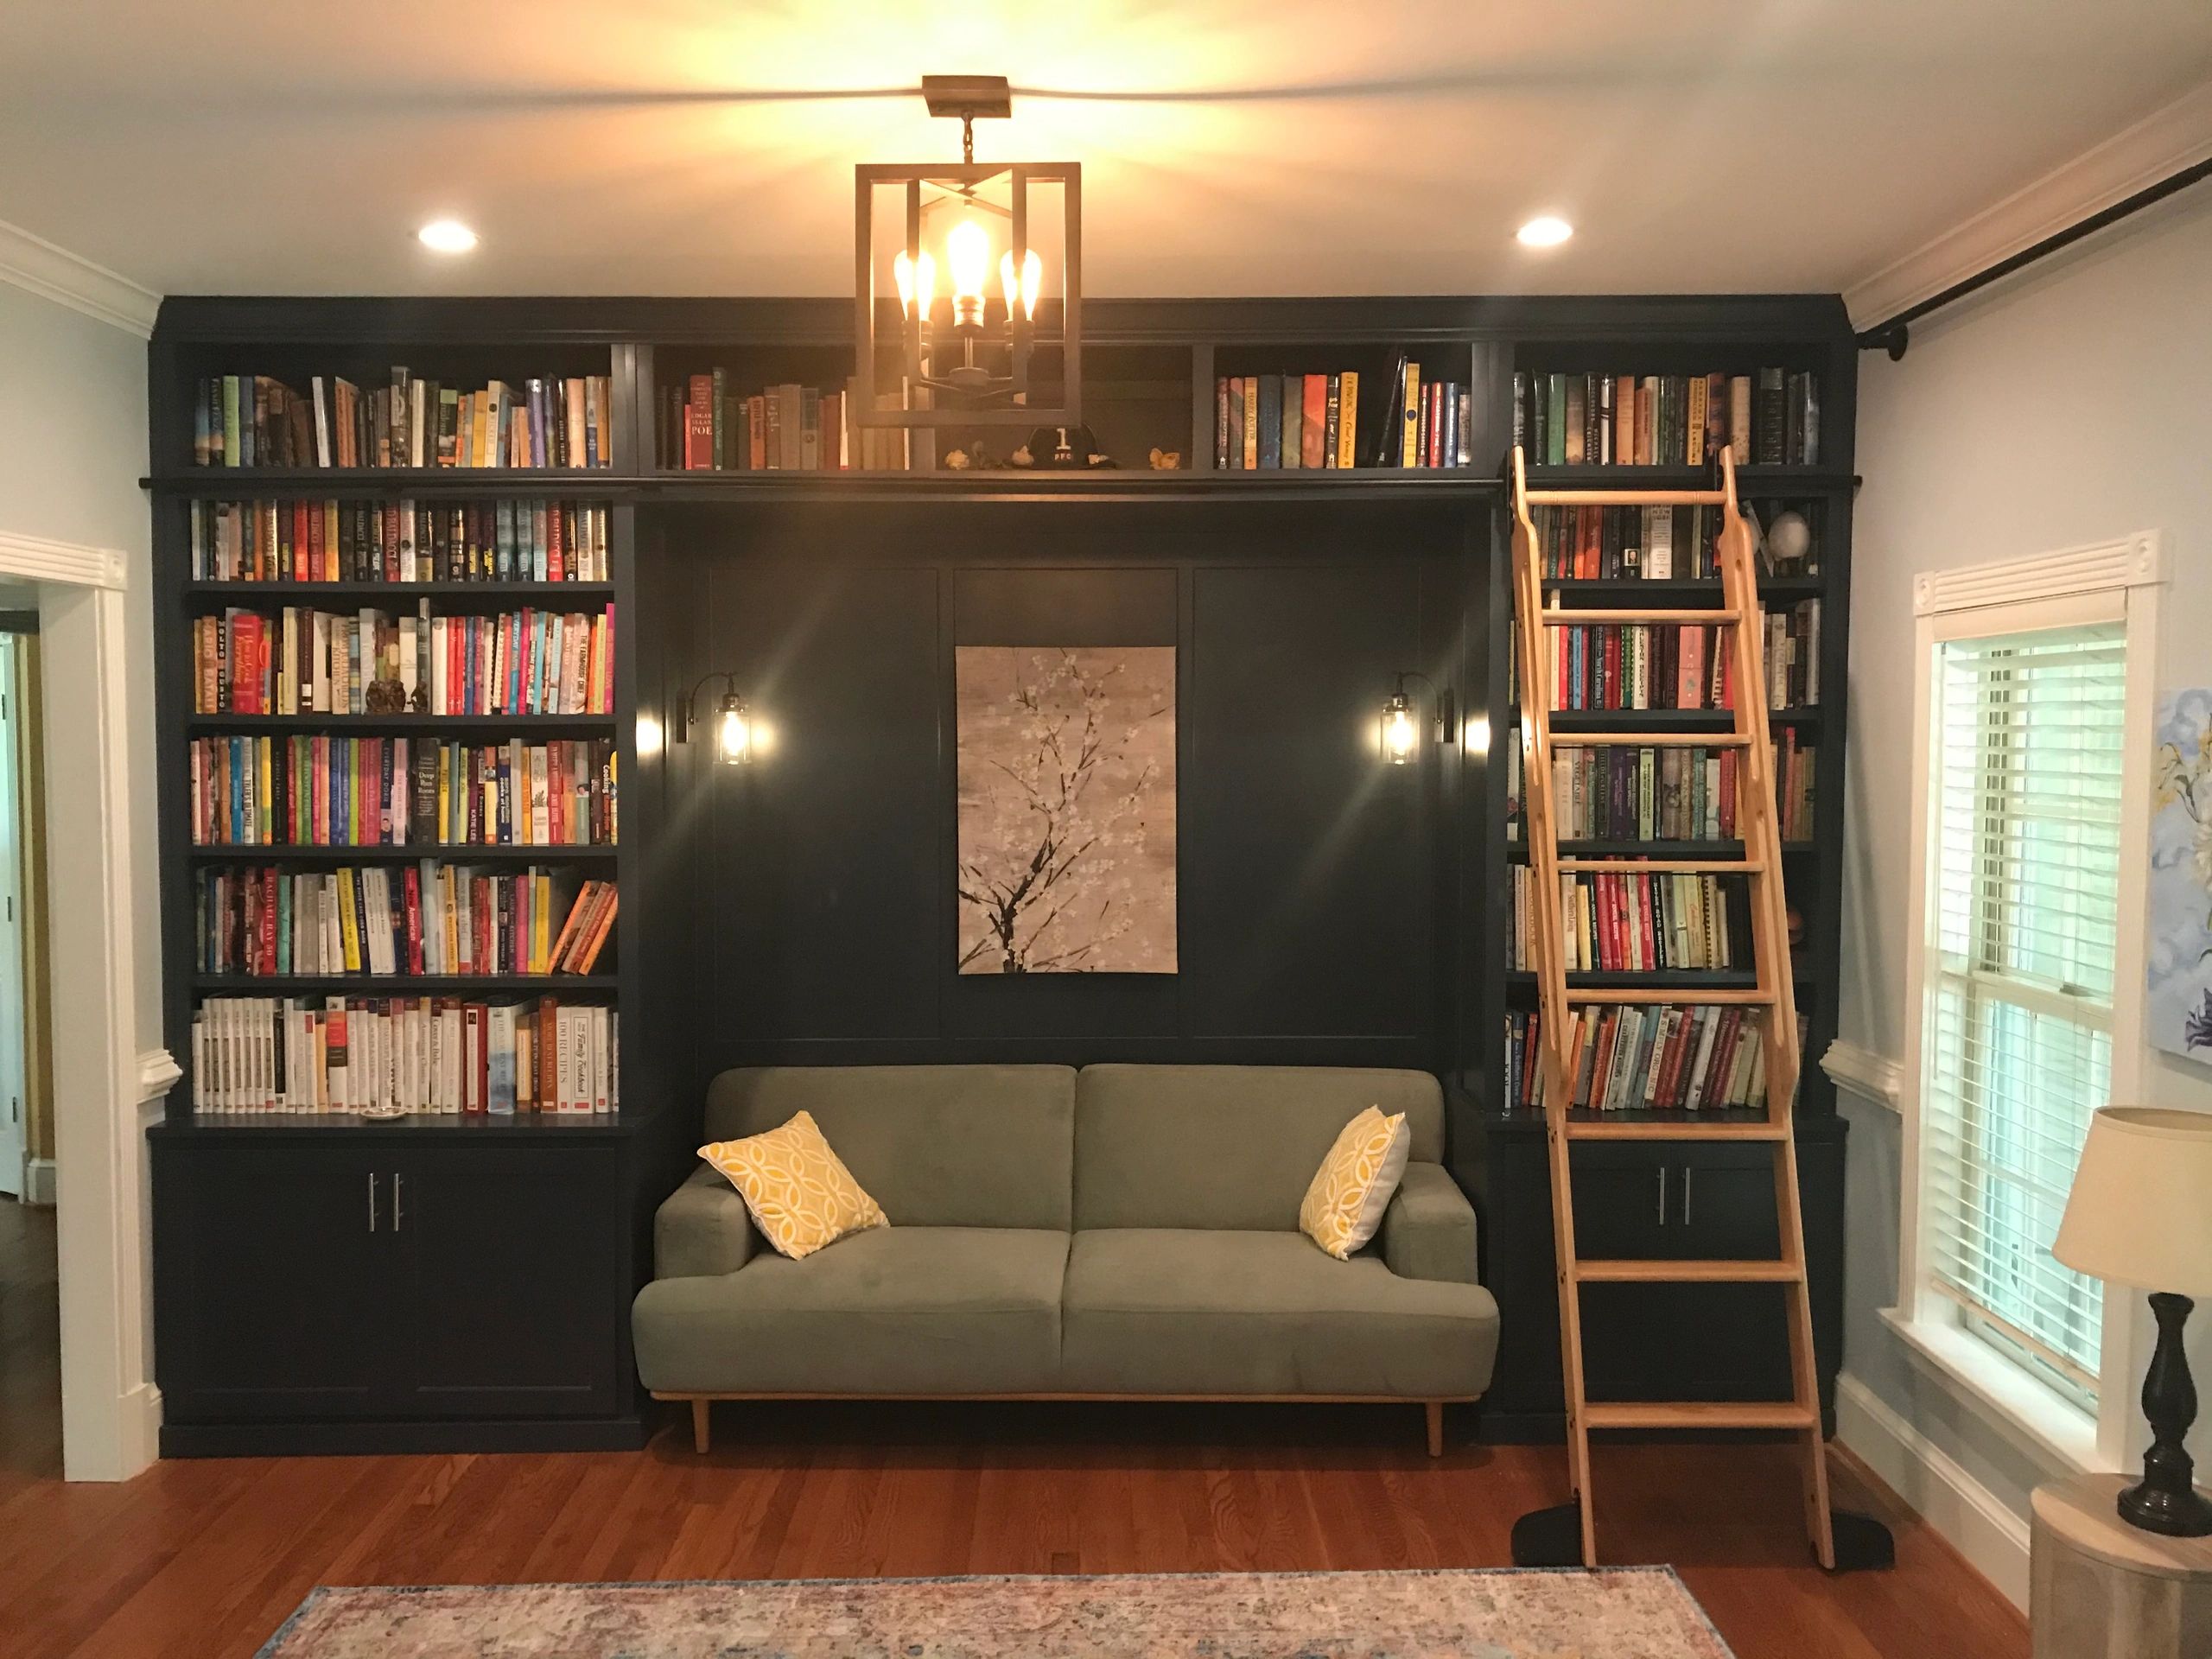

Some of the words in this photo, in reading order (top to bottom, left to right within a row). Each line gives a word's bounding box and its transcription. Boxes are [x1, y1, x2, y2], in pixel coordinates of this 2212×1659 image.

[692, 426, 713, 435] POE
[1057, 429, 1071, 449] 1
[386, 518, 397, 558] BALDACCI
[204, 620, 215, 658] MARIO
[204, 668, 215, 709] BATALI
[575, 1033, 586, 1058] Family
[1656, 1020, 1667, 1051] SIMPLY
[577, 1059, 587, 1093] Cookbook
[1648, 1052, 1661, 1092] ORGANIC
